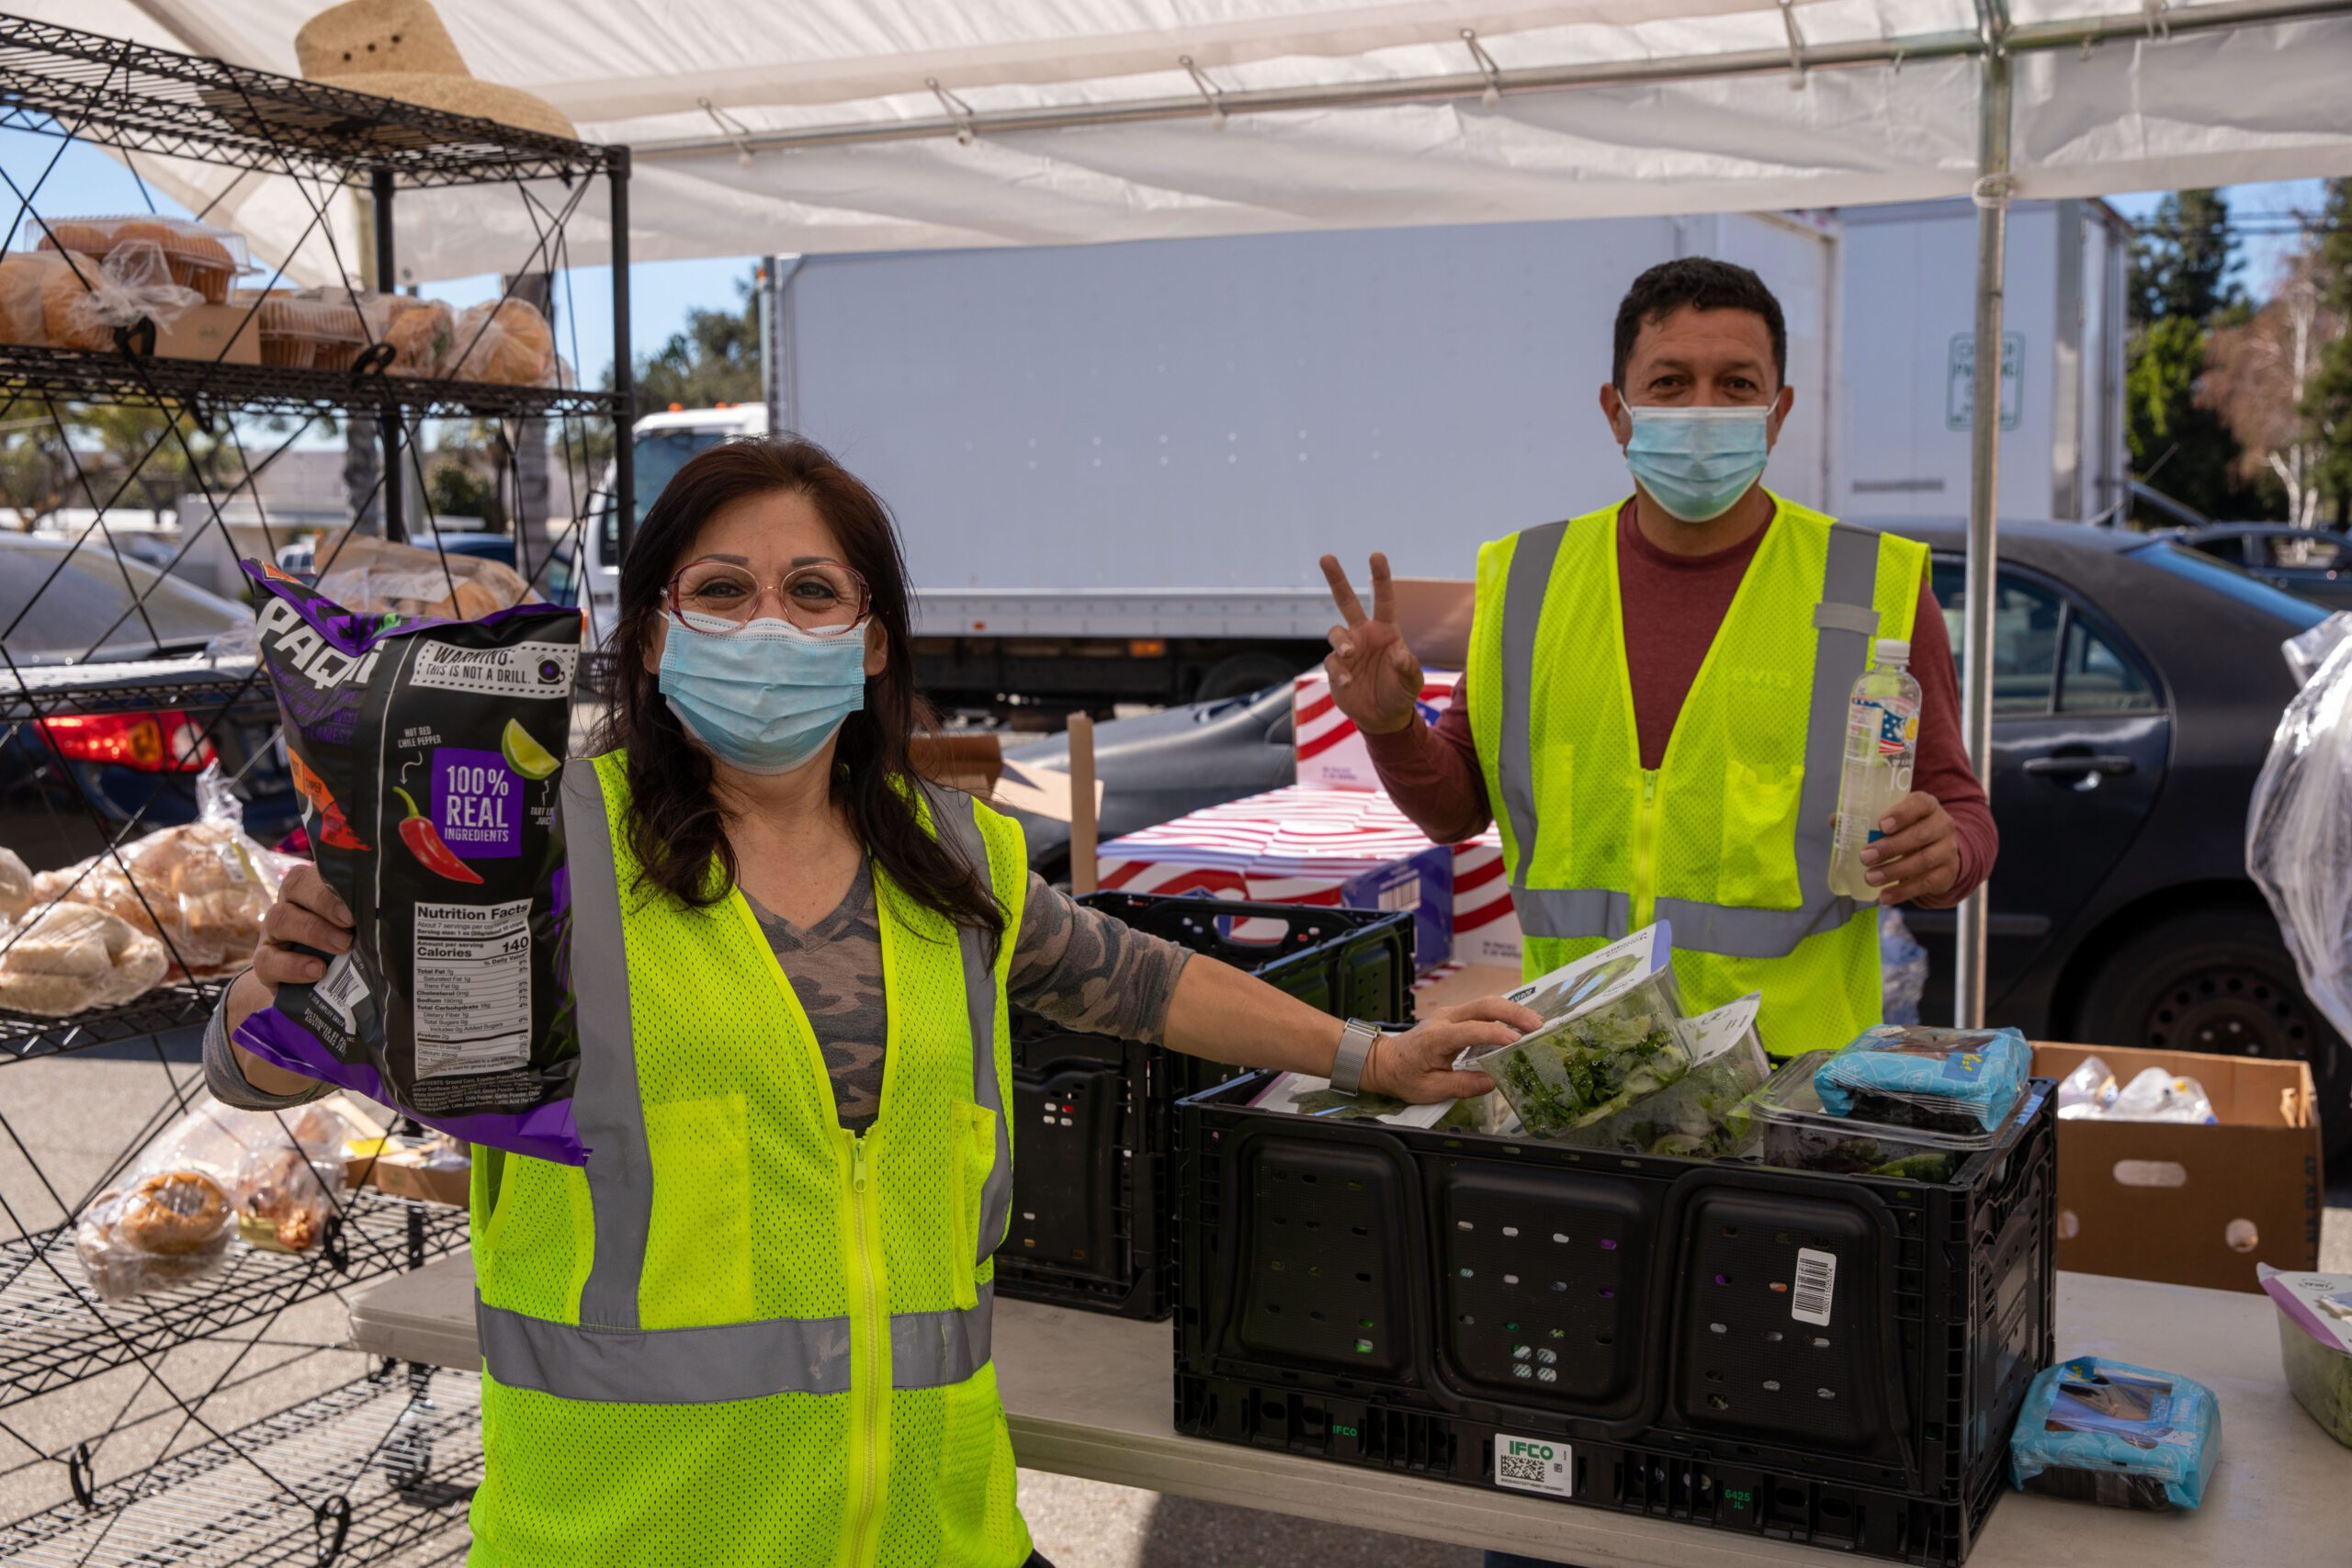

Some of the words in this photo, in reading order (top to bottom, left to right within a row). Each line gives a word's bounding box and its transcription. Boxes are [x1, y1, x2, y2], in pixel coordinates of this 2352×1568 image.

[426, 663, 447, 676] THIS
[449, 665, 459, 677] IS
[463, 666, 483, 680] NOT
[487, 670, 493, 681] A
[497, 669, 531, 684] DRILL.
[404, 728, 417, 738] HOT
[419, 726, 432, 736] RED
[398, 738, 416, 749] CHILE
[417, 735, 442, 746] PEPPER
[447, 766, 509, 796] 100%
[446, 795, 509, 828] REAL
[444, 828, 509, 842] INGREDIENTS
[417, 906, 487, 920] Nutrition
[491, 904, 528, 919] Facts
[458, 941, 484, 949] serving
[502, 936, 529, 953] 140
[417, 946, 472, 958] Calories
[492, 956, 508, 965] Daily
[304, 1008, 332, 1032] DISTRIBUTED
[333, 1030, 339, 1039] BY
[1333, 1426, 1357, 1437] IFCO
[1510, 1440, 1554, 1461] IFCO
[1725, 1489, 1750, 1503] 6425
